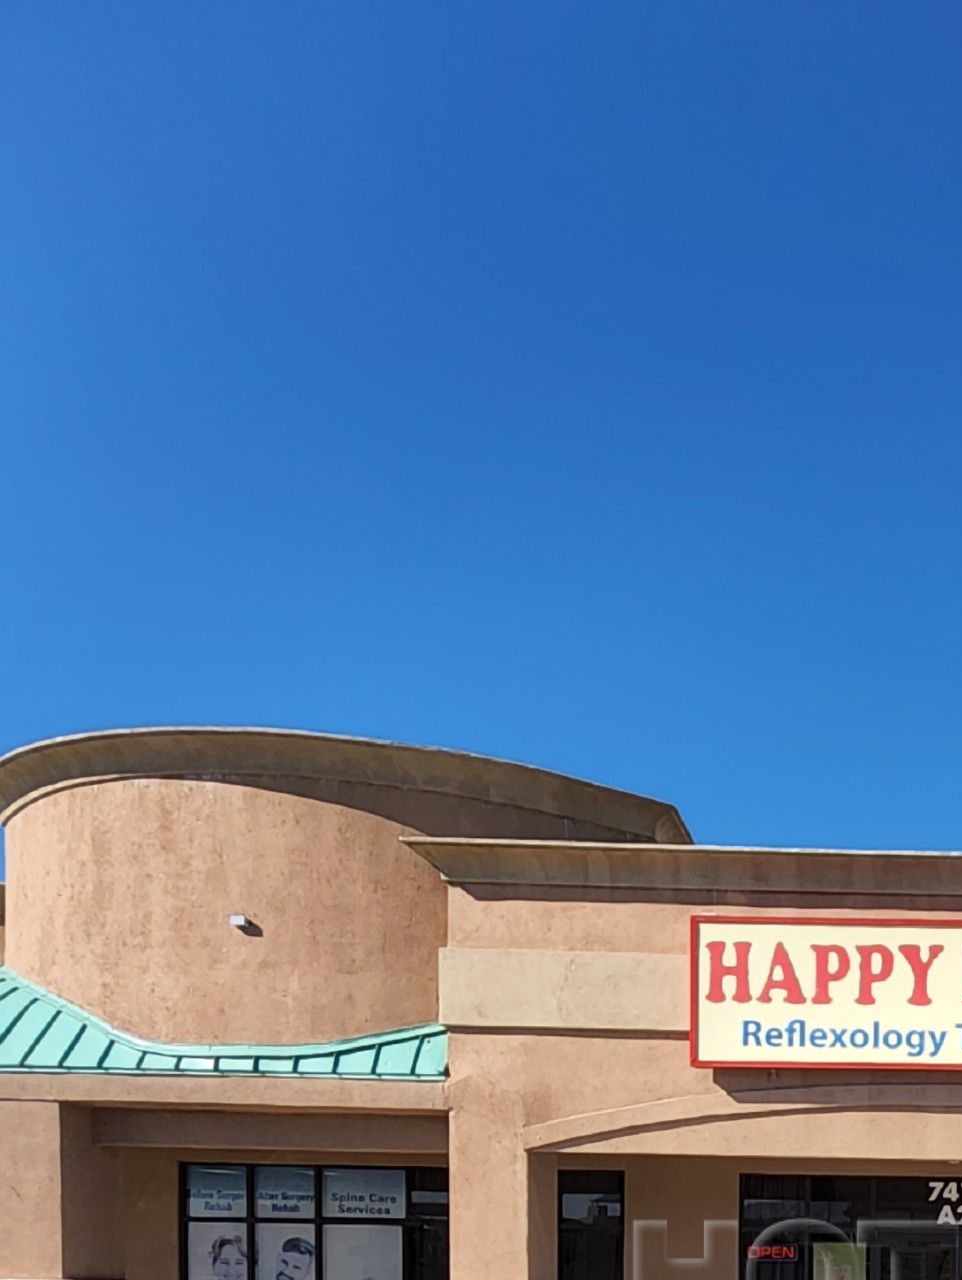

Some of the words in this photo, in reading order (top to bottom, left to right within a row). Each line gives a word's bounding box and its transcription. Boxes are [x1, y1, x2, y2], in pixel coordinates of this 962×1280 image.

[705, 941, 944, 1007] HAPPY
[742, 1020, 947, 1057] Reflexology
[331, 1192, 365, 1204] Spine
[369, 1193, 398, 1204] Care
[338, 1204, 391, 1215] Services
[748, 1246, 795, 1259] OPEN
